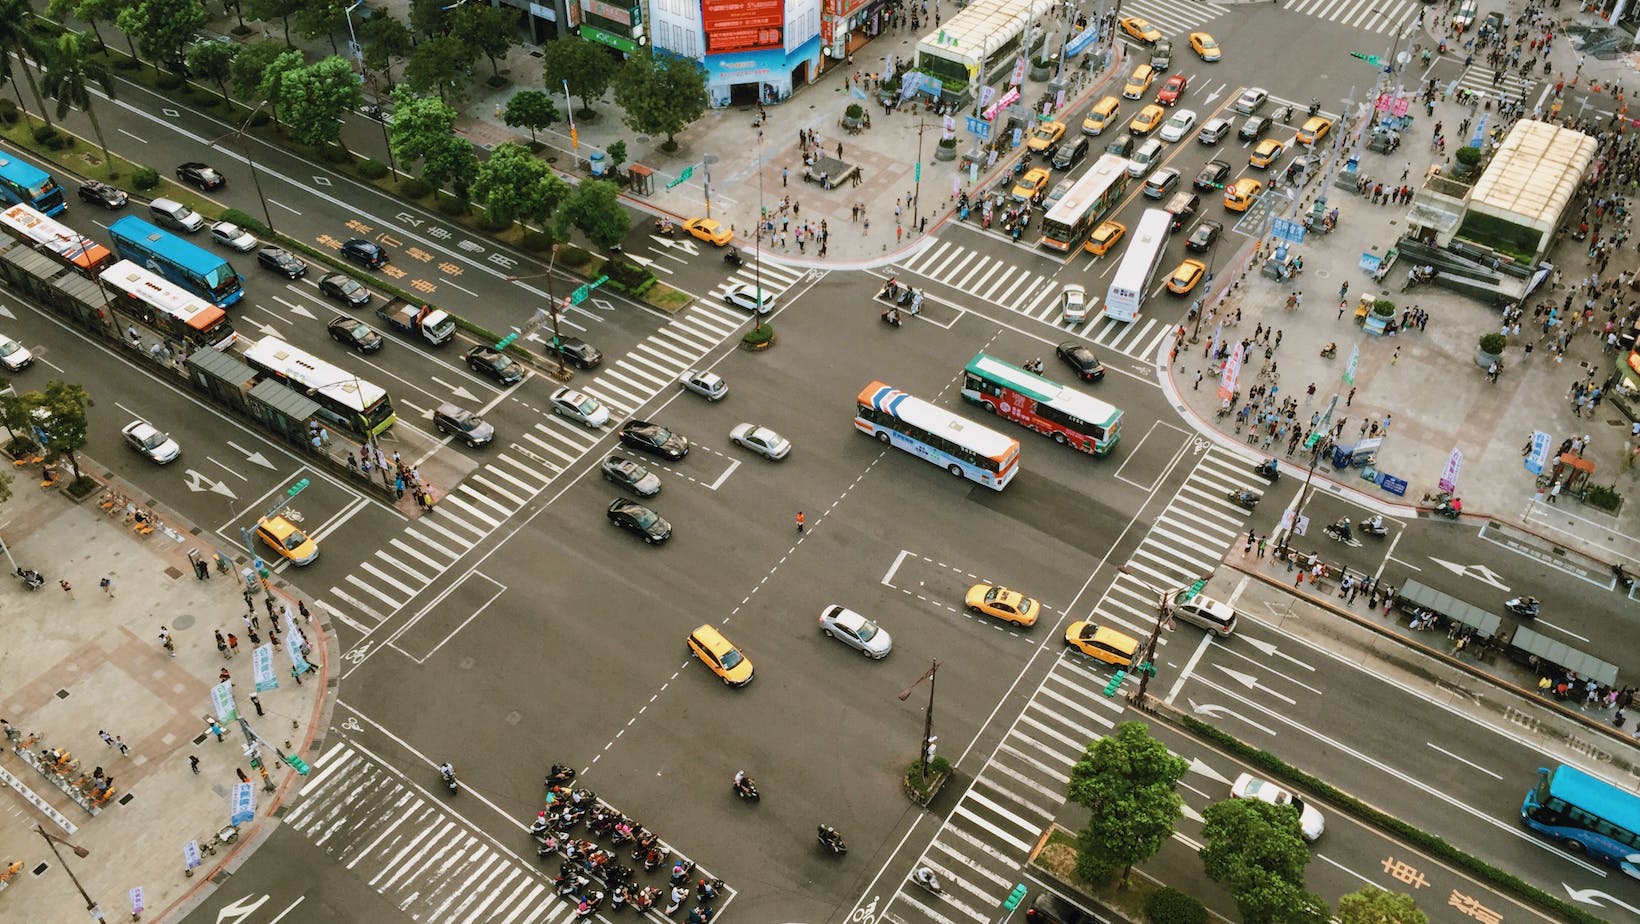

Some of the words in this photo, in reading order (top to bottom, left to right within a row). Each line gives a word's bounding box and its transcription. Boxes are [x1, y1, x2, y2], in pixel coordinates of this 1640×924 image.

[315, 234, 438, 293] 禁機車
[395, 212, 518, 269] 公車專用
